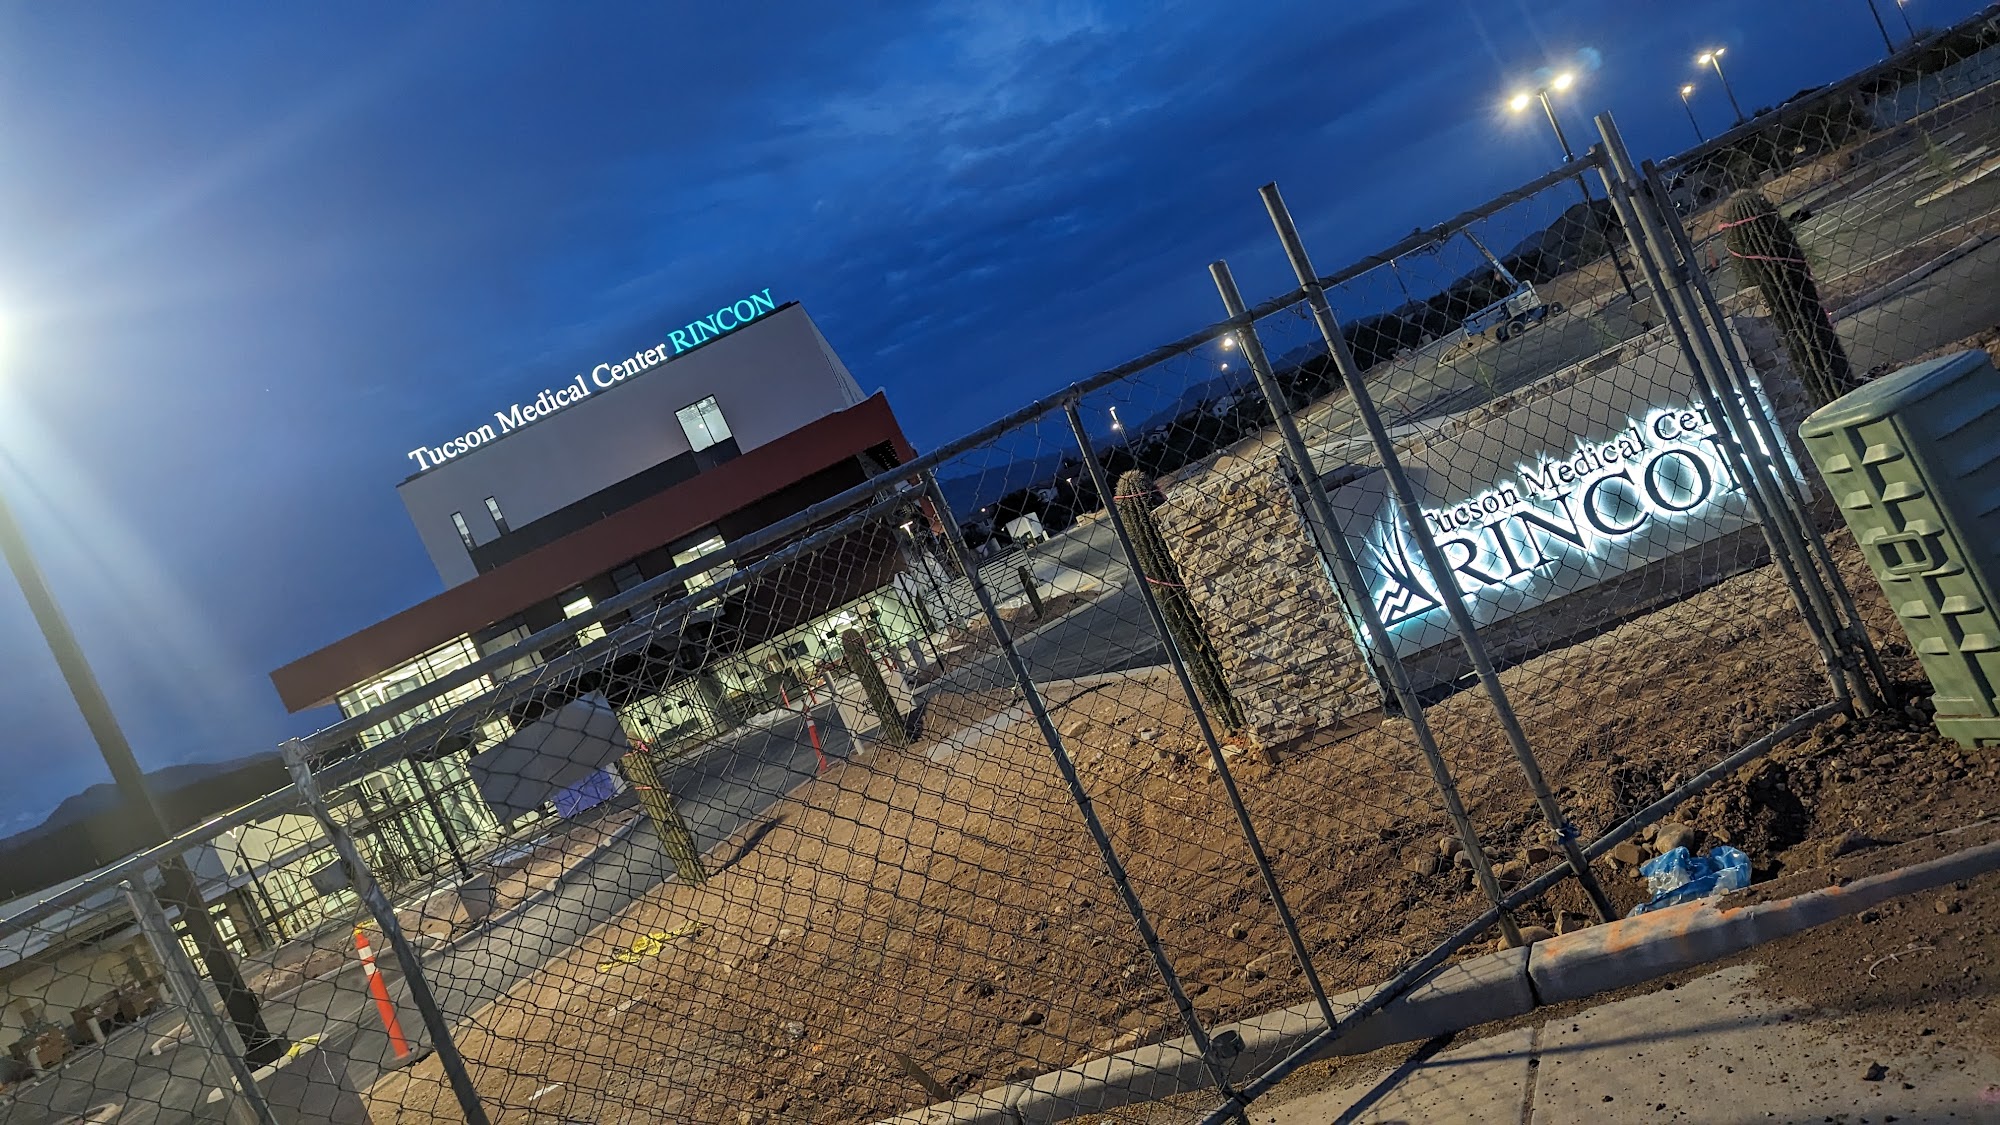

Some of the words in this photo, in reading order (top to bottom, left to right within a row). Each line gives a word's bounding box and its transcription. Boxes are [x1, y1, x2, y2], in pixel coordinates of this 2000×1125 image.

[407, 423, 497, 471] Tucson
[493, 374, 592, 434] Medical
[591, 342, 668, 388] Center
[667, 288, 776, 354] RINCON
[1521, 426, 1648, 497] Medical
